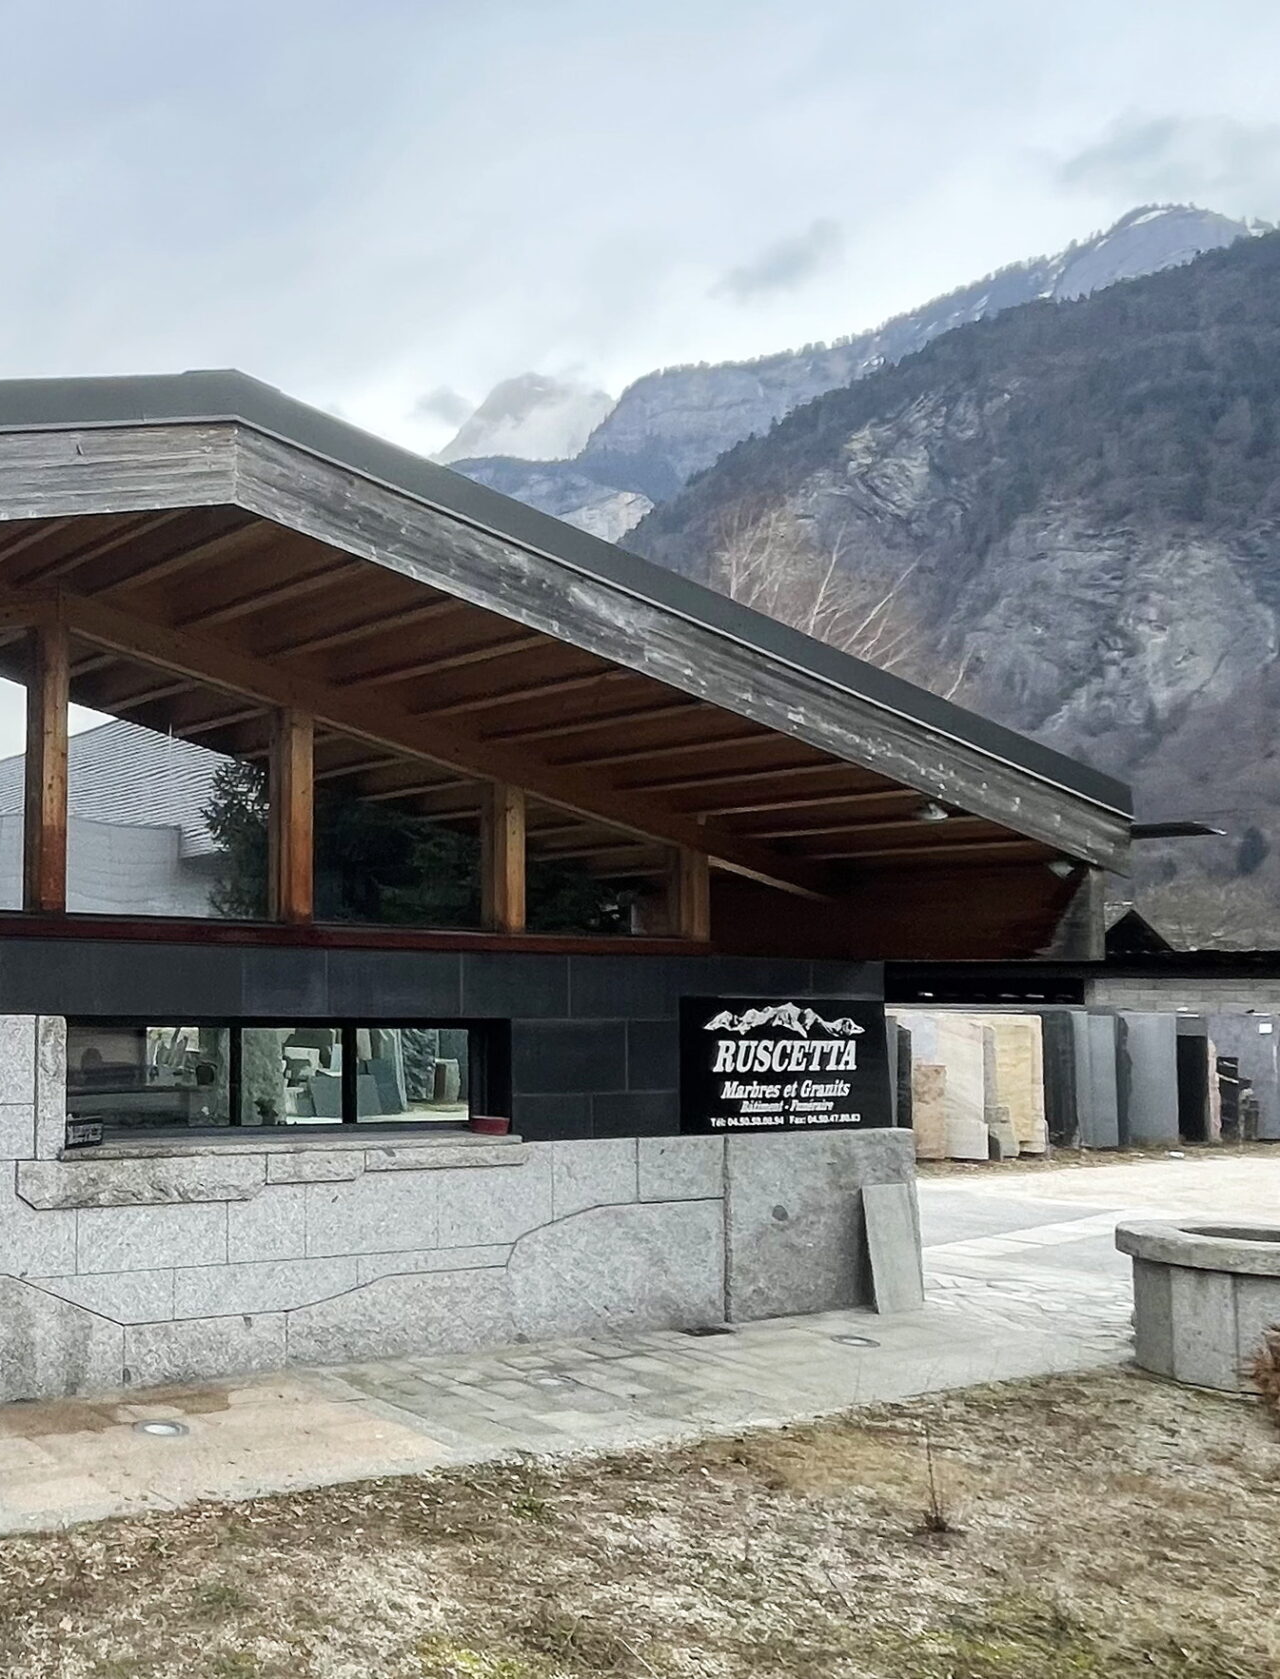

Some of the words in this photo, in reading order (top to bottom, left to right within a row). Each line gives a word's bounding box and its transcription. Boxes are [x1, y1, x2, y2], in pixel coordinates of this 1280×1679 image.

[712, 1040, 858, 1073] RUSCETTA
[720, 1080, 780, 1100] Marbres
[783, 1081, 798, 1098] et
[800, 1079, 851, 1099] Granits
[740, 1100, 784, 1114] Bâtiment
[790, 1099, 834, 1112] Funéraire
